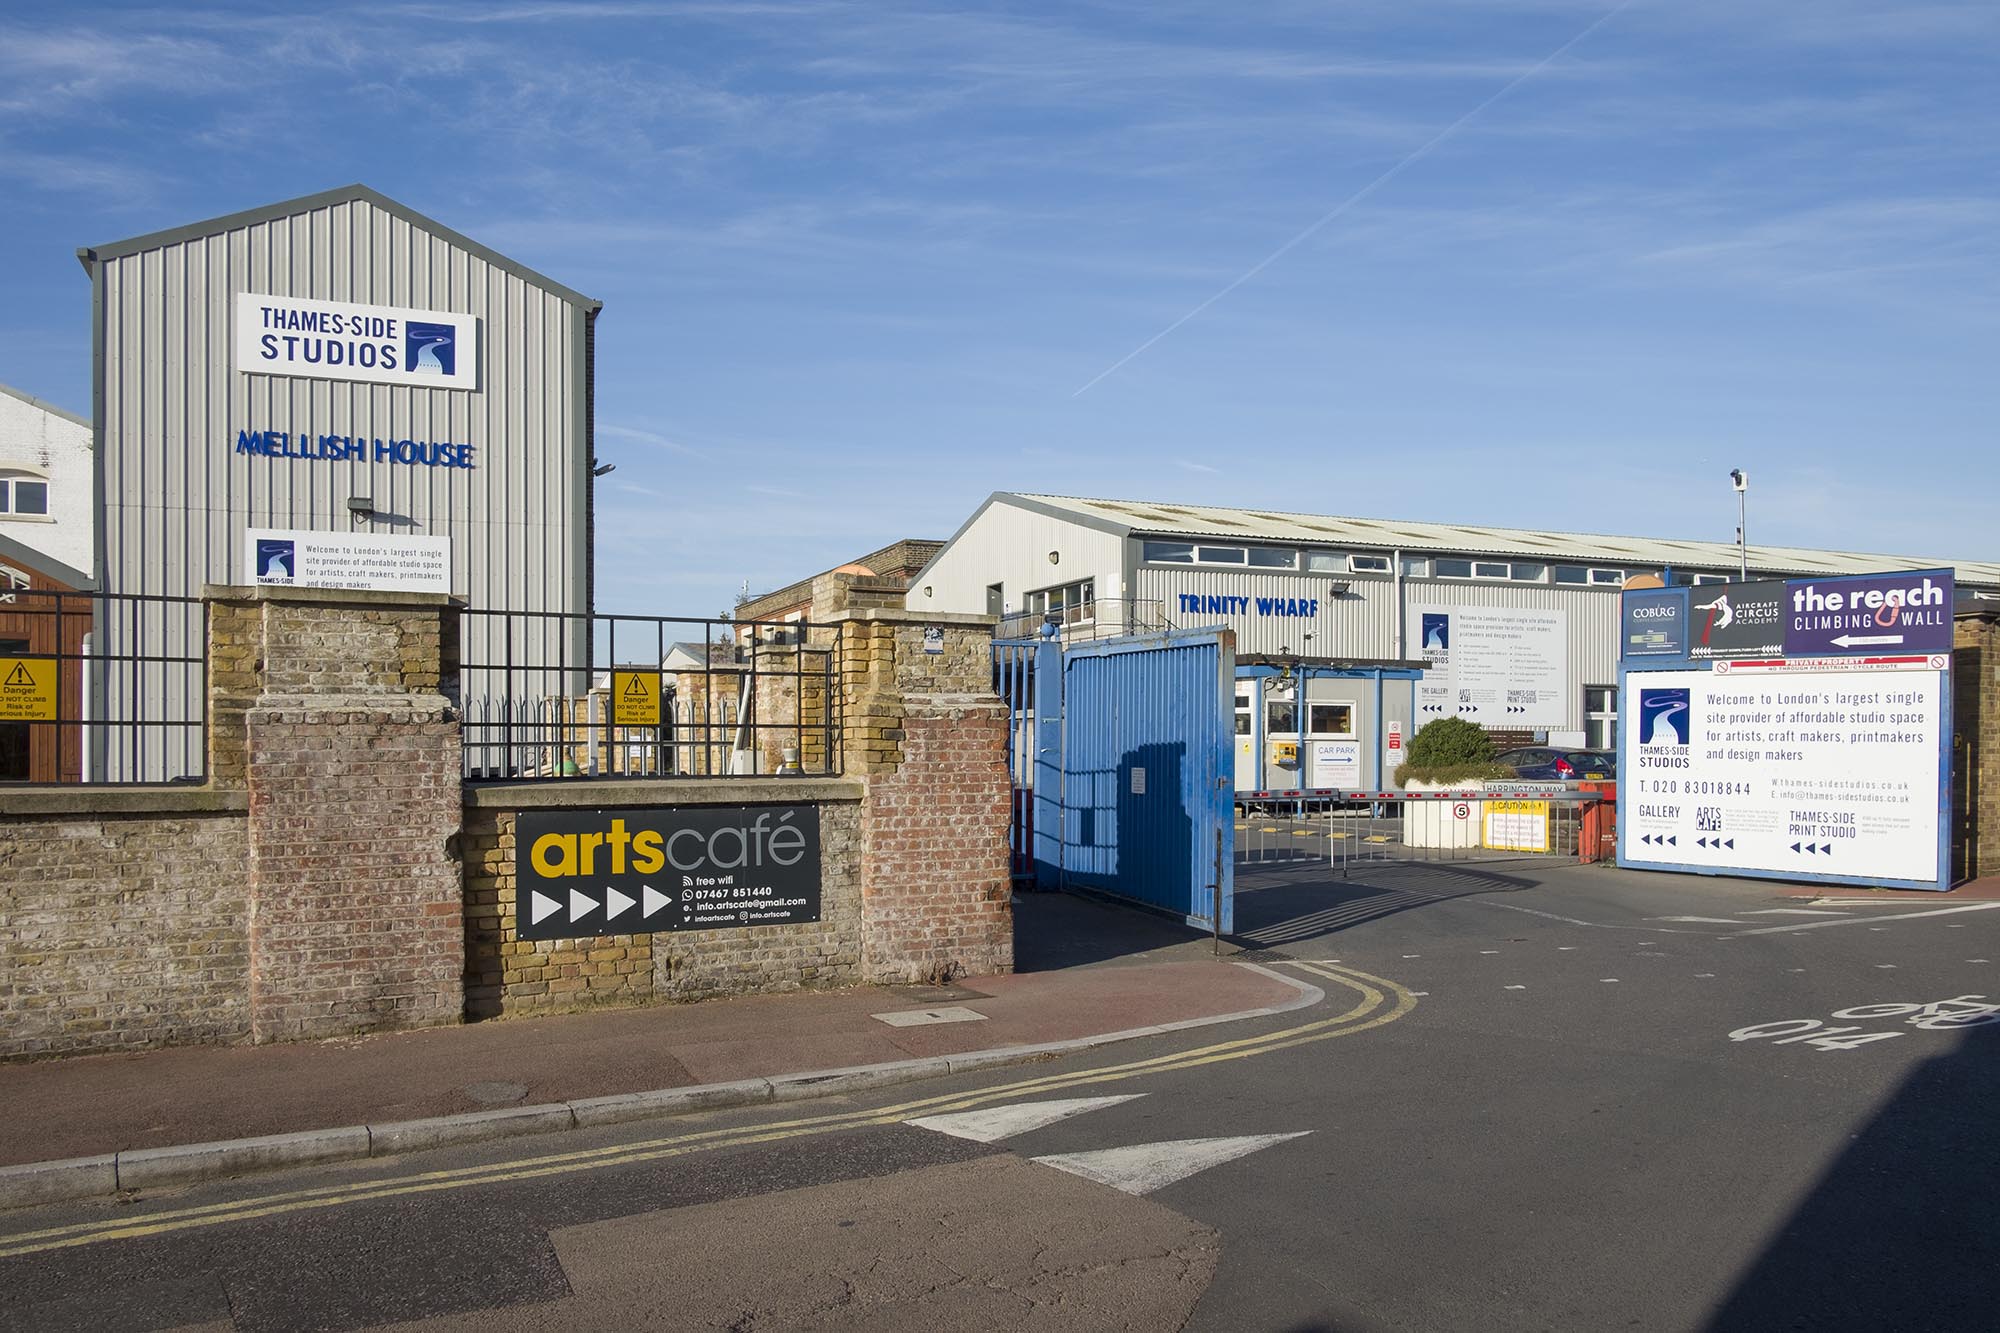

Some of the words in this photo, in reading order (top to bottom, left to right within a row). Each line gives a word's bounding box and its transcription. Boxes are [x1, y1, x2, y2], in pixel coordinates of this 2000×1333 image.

[261, 306, 398, 339] THAMES-SIDE
[260, 334, 398, 370] STUDIOS
[236, 429, 364, 462] MELLISH
[374, 438, 474, 469] HOUSE
[306, 545, 339, 554] Welcome
[343, 546, 350, 554] to
[354, 546, 387, 556] London's
[390, 548, 417, 558] largest
[420, 550, 442, 558] single
[306, 557, 319, 565] site
[322, 558, 350, 568] provider
[353, 558, 359, 566] of
[362, 558, 397, 567] affordable
[400, 560, 420, 568] studio
[423, 562, 442, 570] space
[306, 568, 316, 576] for
[400, 571, 442, 580] printmakers
[306, 580, 318, 588] and
[321, 580, 344, 588] design
[346, 581, 371, 589] makers
[1793, 586, 1843, 612] the
[1850, 579, 1943, 609] reach
[1179, 594, 1249, 616] TRINITY
[1256, 598, 1318, 618] WHARF
[1633, 604, 1675, 618] COBURG
[1736, 601, 1778, 610] AIRCRAFT
[1735, 608, 1779, 618] CIRCUS
[1735, 617, 1778, 625] ACADEMY
[1795, 614, 1871, 630] CLIMBING
[1901, 611, 1943, 626] WALL
[1422, 656, 1449, 664] STUDIOS
[4, 687, 36, 695] Danger
[1706, 694, 1754, 705] Welcome
[1761, 694, 1771, 705] to
[1778, 692, 1829, 704] London's
[1836, 692, 1879, 706] largest
[1886, 691, 1924, 706] single
[1706, 712, 1726, 723] site
[1730, 712, 1771, 725] provider
[1776, 712, 1785, 723] of
[1790, 712, 1845, 723] affordable
[1850, 712, 1885, 723] studio
[1890, 713, 1924, 725] space
[1706, 730, 1720, 741] for
[1726, 730, 1765, 742] artists,
[1769, 730, 1794, 741] craft
[1800, 730, 1844, 743] makers,
[1851, 731, 1924, 744] printmakers
[1640, 746, 1689, 756] THAMES-SIDE
[1706, 749, 1723, 759] and
[1728, 749, 1760, 762] design
[1766, 749, 1803, 760] makers
[1640, 757, 1689, 768] STUDIOS
[1640, 780, 1648, 792] T.
[1653, 780, 1676, 793] 020
[1685, 781, 1750, 795] 83018844
[1459, 808, 1465, 816] 5
[1640, 804, 1680, 818] GALLERY
[1696, 807, 1721, 819] ARTS
[1790, 811, 1855, 824] THAMES-SIDE
[1789, 824, 1816, 836] PRINT
[1820, 825, 1856, 838] STUDIO
[530, 810, 806, 878] artscafé
[696, 876, 715, 886] free
[718, 875, 734, 884] wifi
[696, 889, 729, 900] 07467
[733, 887, 772, 897] 851440
[697, 897, 806, 911] info.artscafe@gmail.com
[695, 914, 735, 922] infoartscafe
